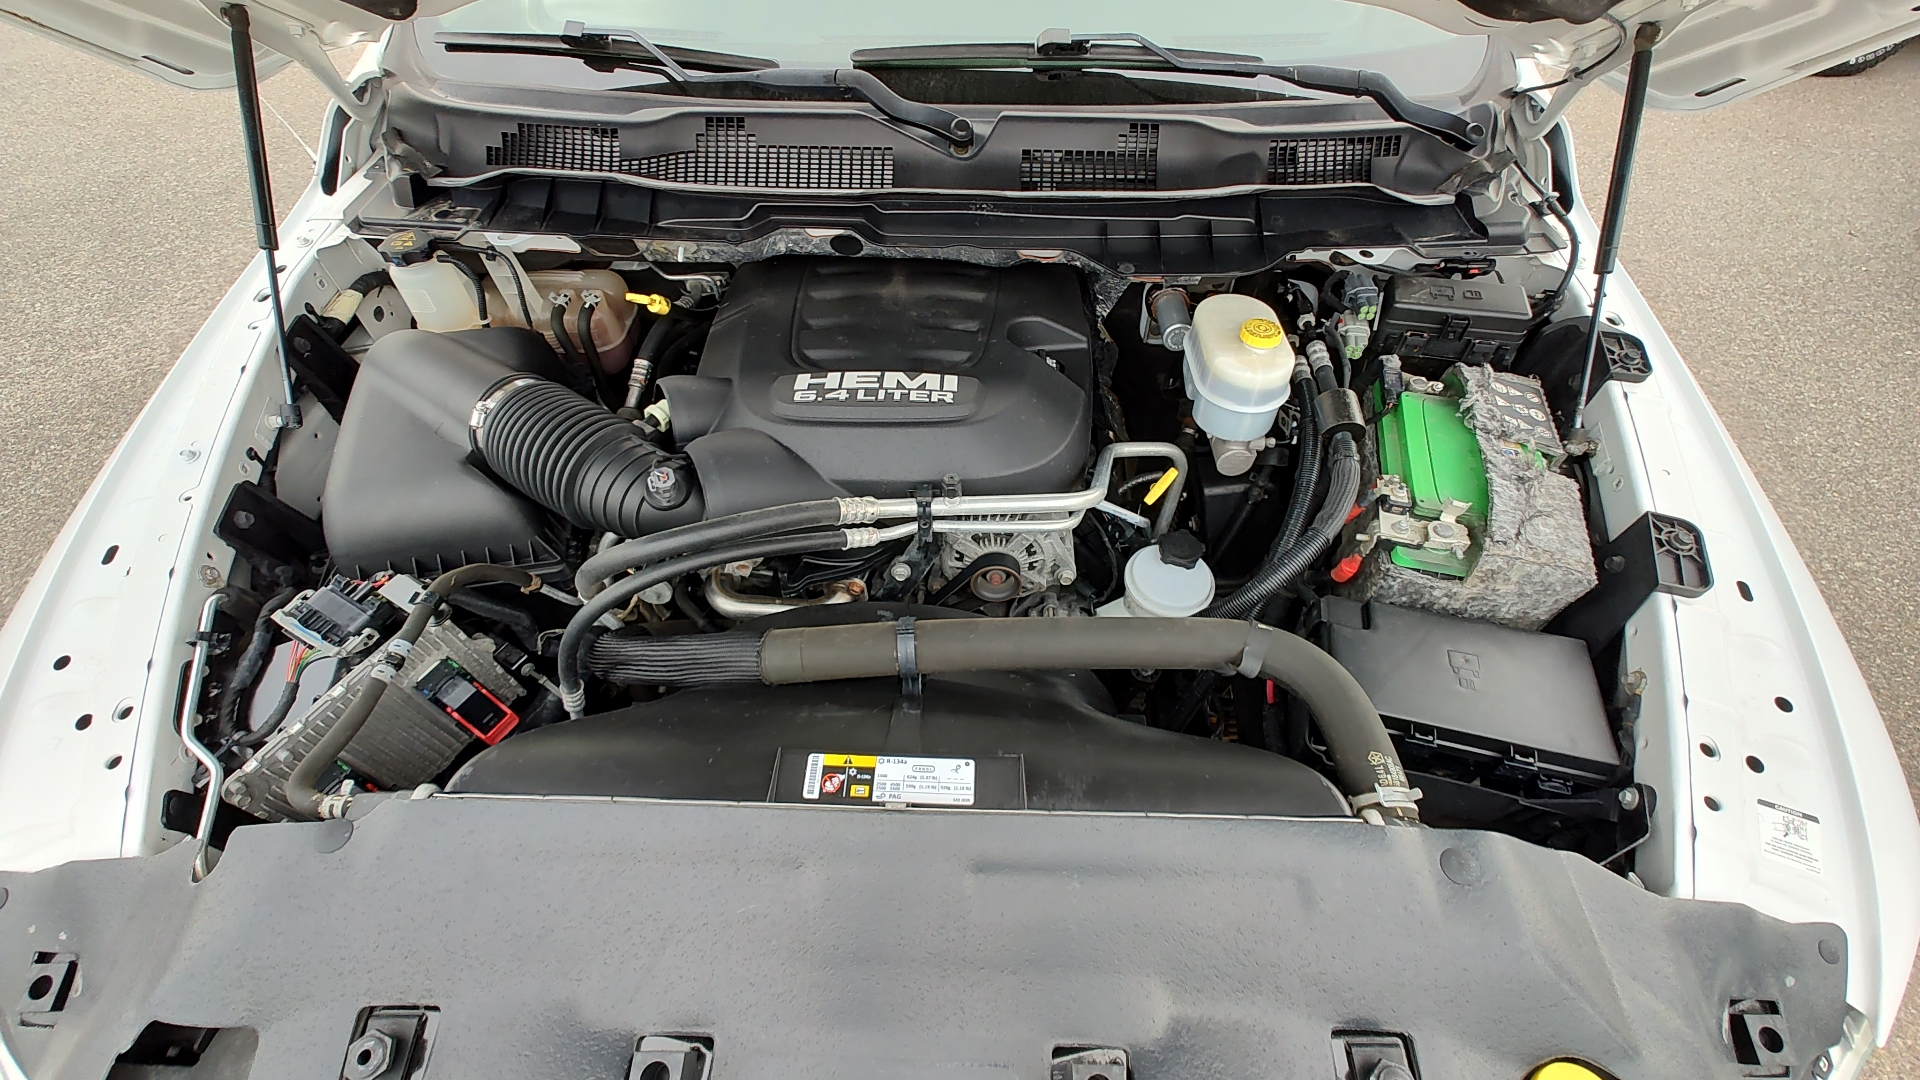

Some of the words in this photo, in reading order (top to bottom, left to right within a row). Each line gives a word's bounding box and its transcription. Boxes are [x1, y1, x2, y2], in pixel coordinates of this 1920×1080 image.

[794, 371, 958, 392] HEMI
[794, 390, 850, 403] 6.4
[856, 390, 954, 404] LITER
[1775, 805, 1803, 818] CAUTION
